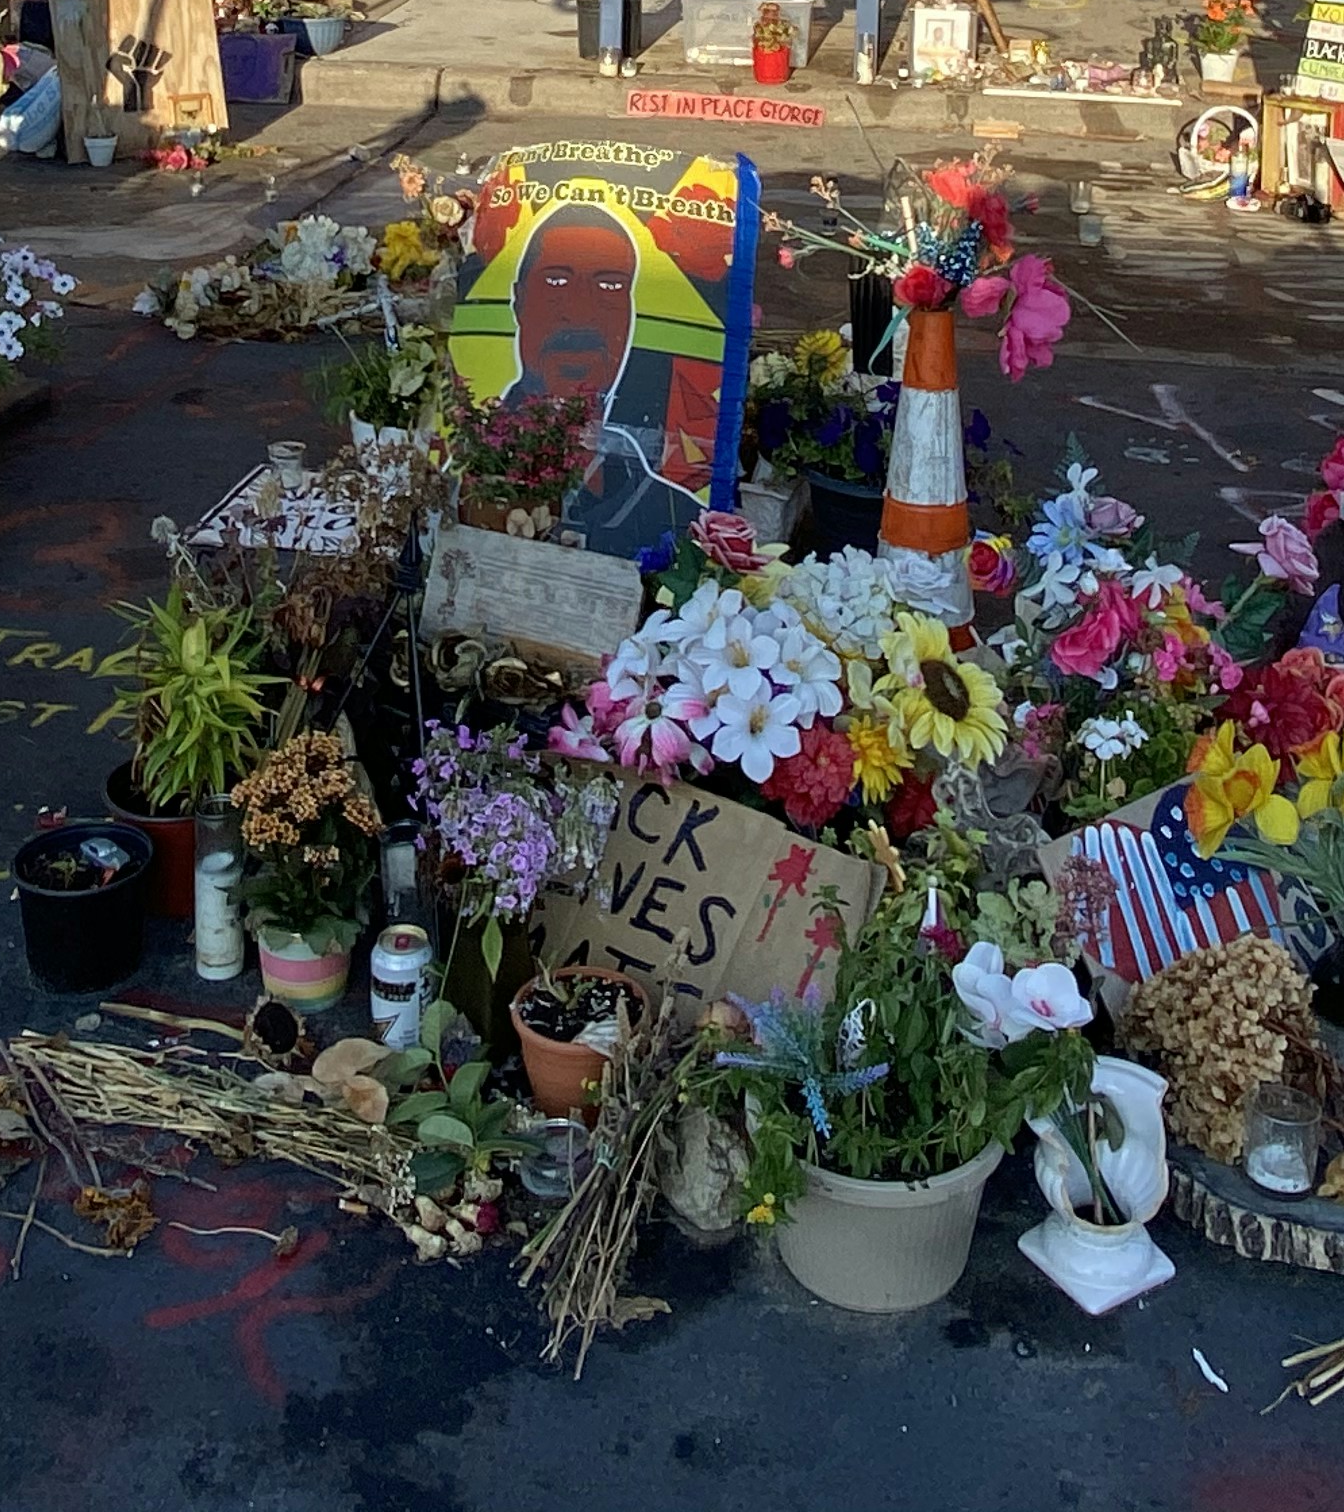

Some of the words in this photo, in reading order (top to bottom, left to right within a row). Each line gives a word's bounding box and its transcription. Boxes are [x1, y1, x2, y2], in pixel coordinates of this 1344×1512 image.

[630, 93, 668, 113] REST
[676, 97, 696, 115] IN
[701, 97, 754, 119] PEACE
[760, 100, 822, 126] GEORGE
[490, 186, 513, 205] So
[518, 183, 549, 202] We
